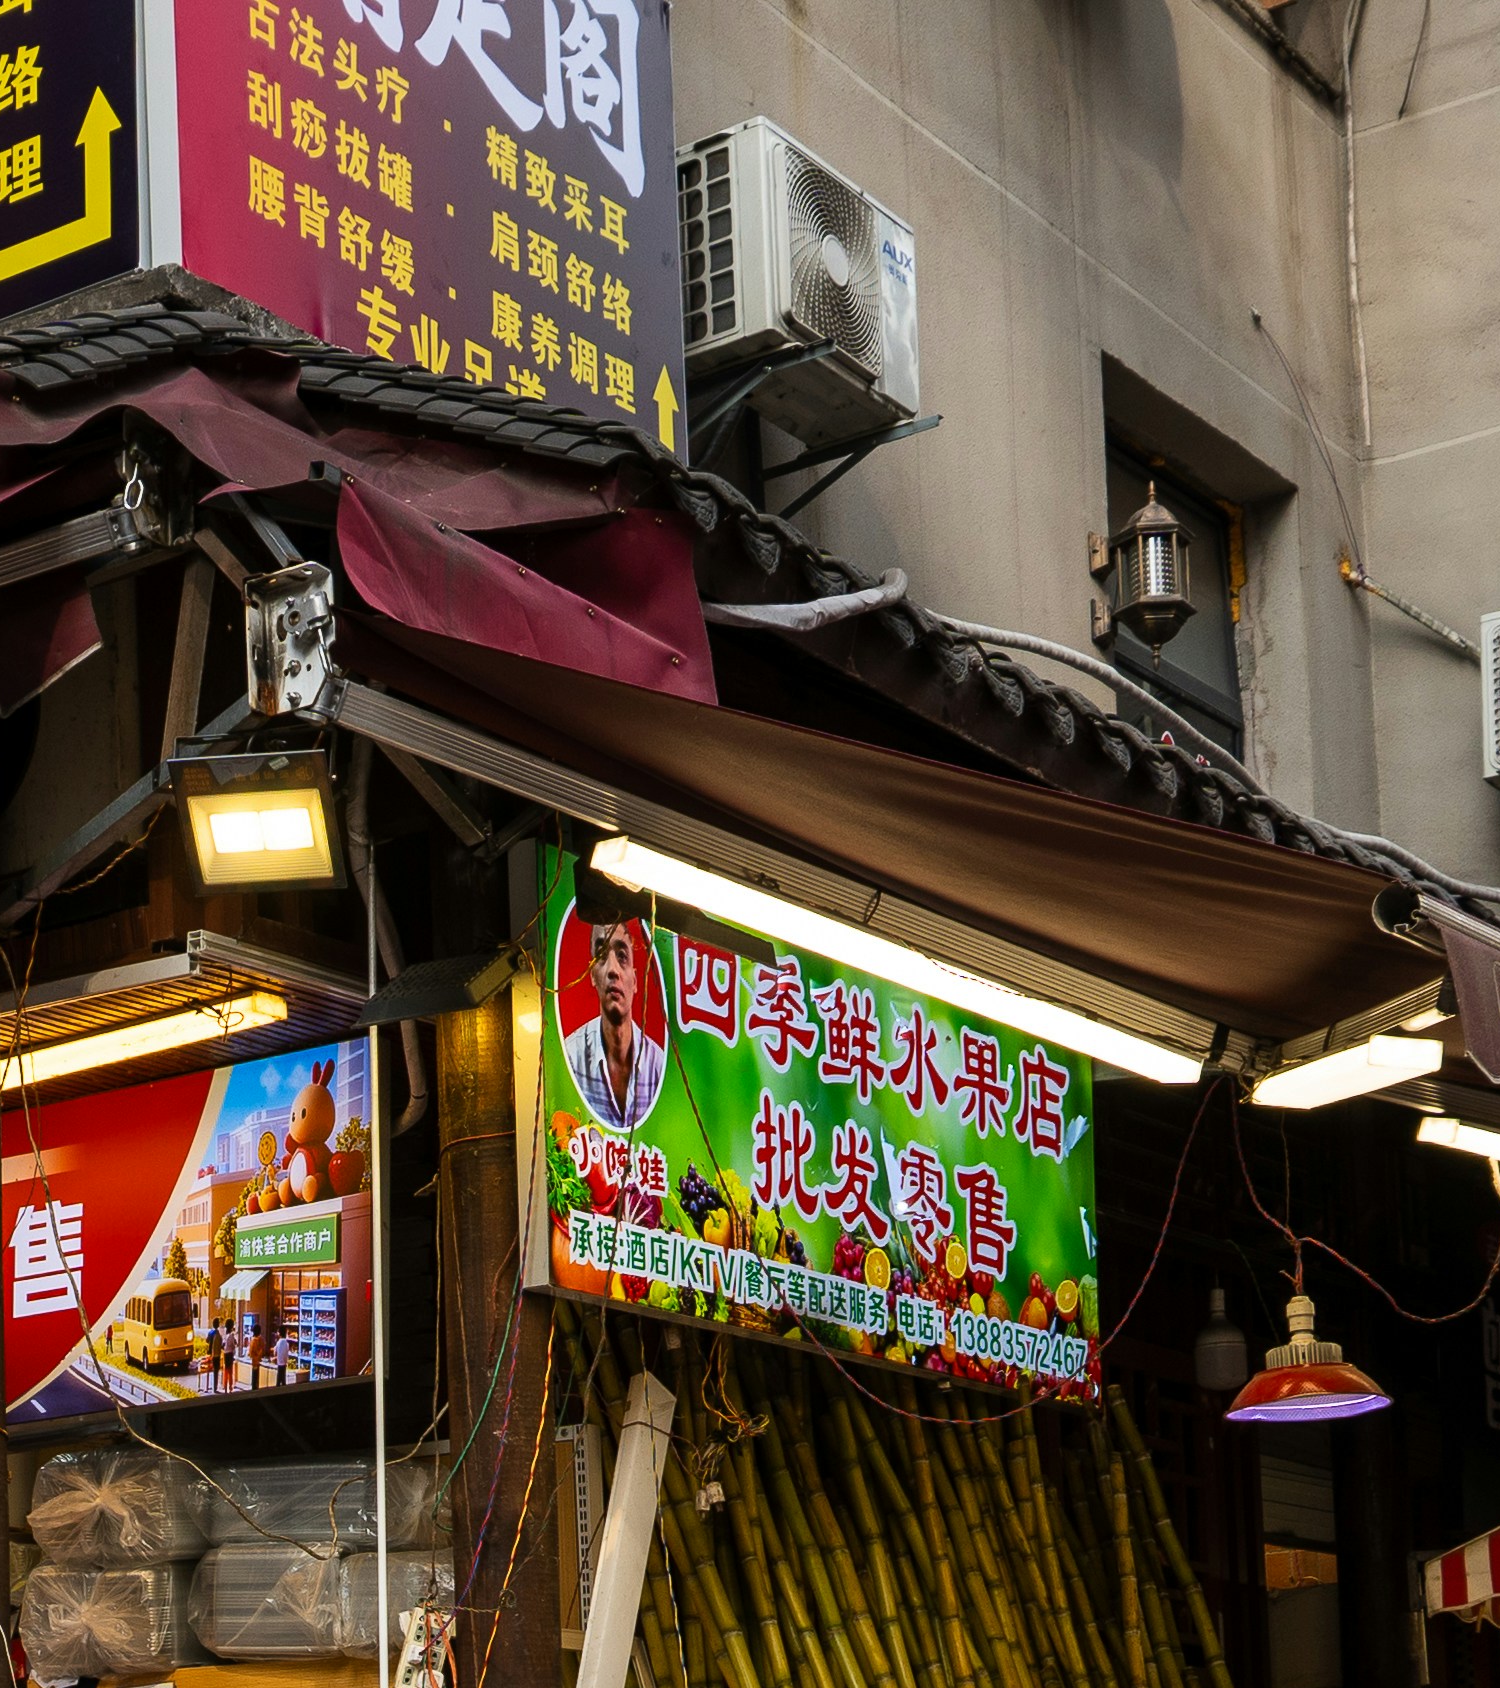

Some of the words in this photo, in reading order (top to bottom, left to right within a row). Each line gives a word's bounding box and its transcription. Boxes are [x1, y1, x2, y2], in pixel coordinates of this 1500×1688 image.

[247, 69, 415, 214] 刮痧拔罐
[490, 210, 634, 337] 肩颈舒络
[248, 155, 416, 298] 腰背舒缓
[491, 290, 638, 415] 康养调理
[485, 125, 630, 256] 精致采耳
[882, 239, 913, 273] AUX
[672, 934, 1071, 1164] 四季鲜水果店
[238, 1228, 333, 1259] 渝快荟合作商户
[752, 1091, 1018, 1282] 批发零售
